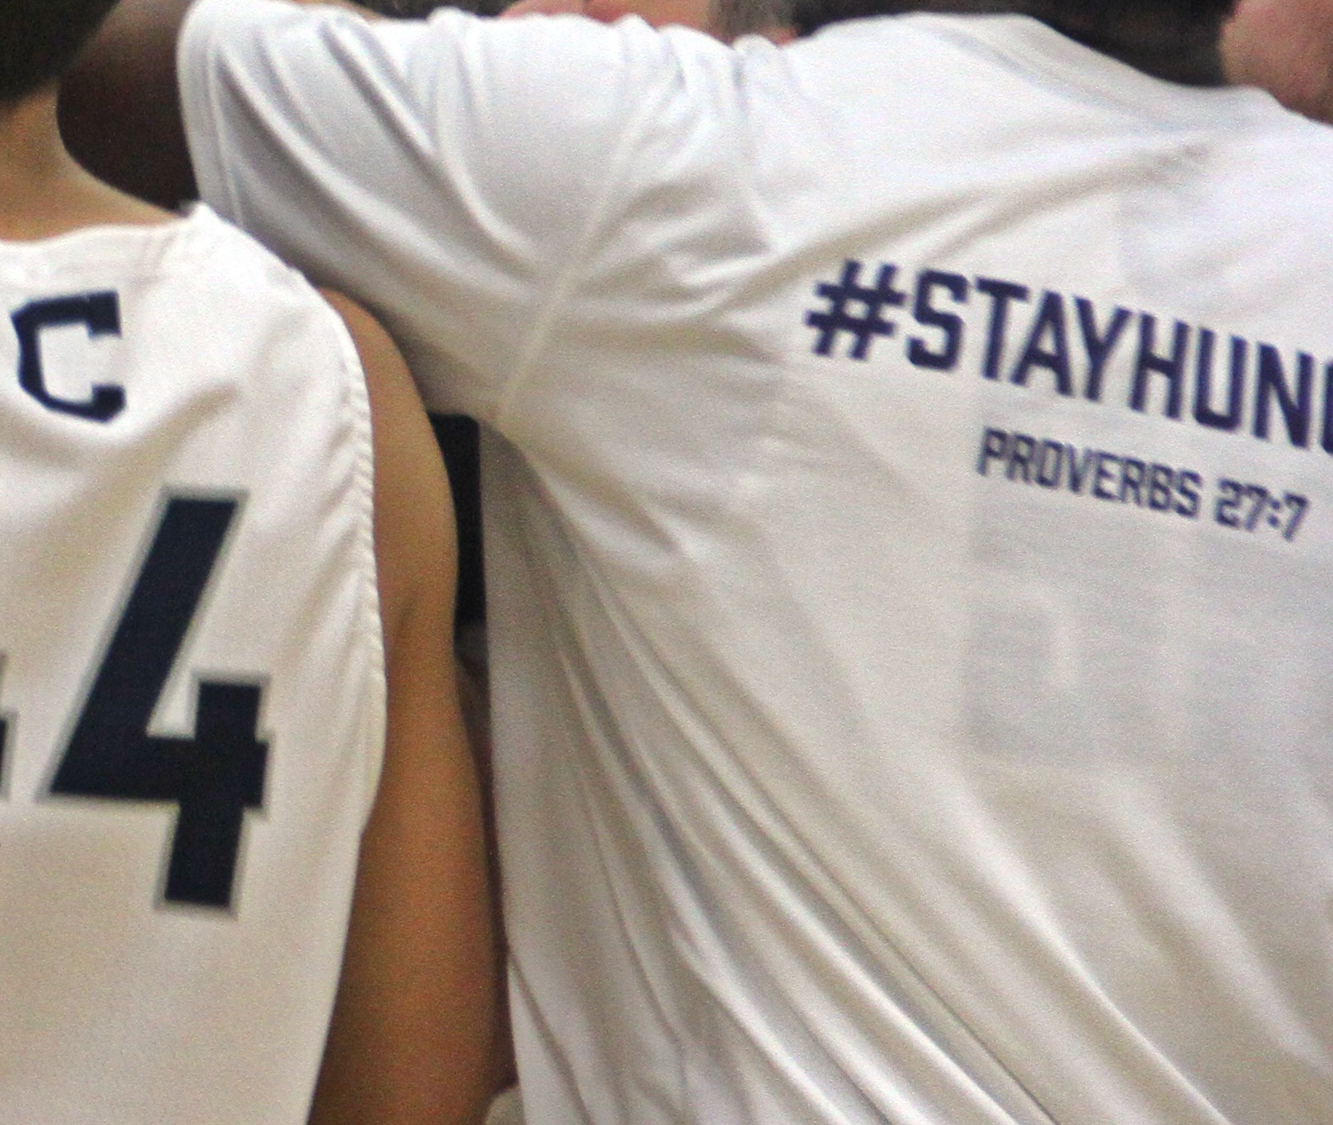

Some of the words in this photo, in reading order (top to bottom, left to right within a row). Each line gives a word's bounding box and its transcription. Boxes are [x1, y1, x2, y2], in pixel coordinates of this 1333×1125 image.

[10, 289, 127, 424] C
[805, 259, 1333, 457] #STAYHUN
[976, 426, 1203, 520] PROVERBS
[1213, 477, 1310, 543] 27:7
